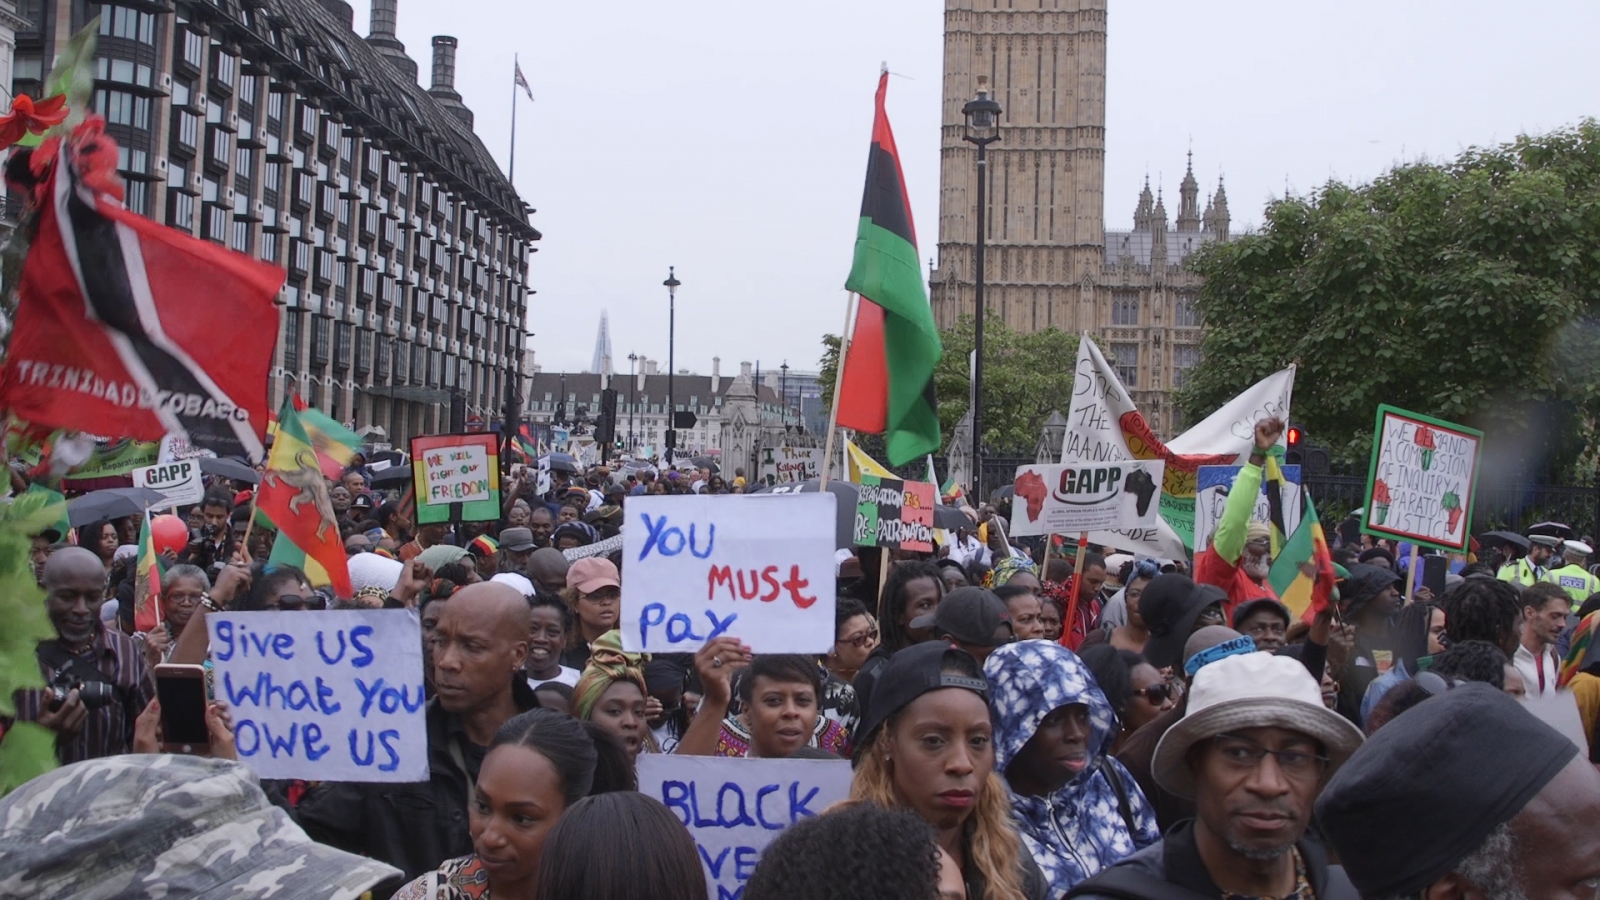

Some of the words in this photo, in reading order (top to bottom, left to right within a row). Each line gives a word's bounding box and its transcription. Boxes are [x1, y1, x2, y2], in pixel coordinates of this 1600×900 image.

[1074, 358, 1121, 405] STOP
[1074, 403, 1110, 430] THE
[1388, 419, 1412, 442] WE
[1414, 425, 1468, 456] DEMAND
[427, 453, 444, 469] WE
[450, 451, 472, 461] WILL
[762, 448, 774, 464] I
[1381, 440, 1392, 461] A
[102, 457, 147, 471] Reparations
[145, 462, 192, 485] GAPP
[430, 469, 454, 481] FIGHT
[431, 479, 488, 499] FREEDOM
[1060, 467, 1121, 494] GAPP
[1396, 464, 1451, 496] INQUIRY
[859, 484, 905, 508] REPARATION
[638, 513, 715, 562] YOU
[1560, 579, 1584, 589] POLICE
[215, 620, 295, 662] give
[316, 625, 375, 668] US
[348, 728, 400, 771] US
